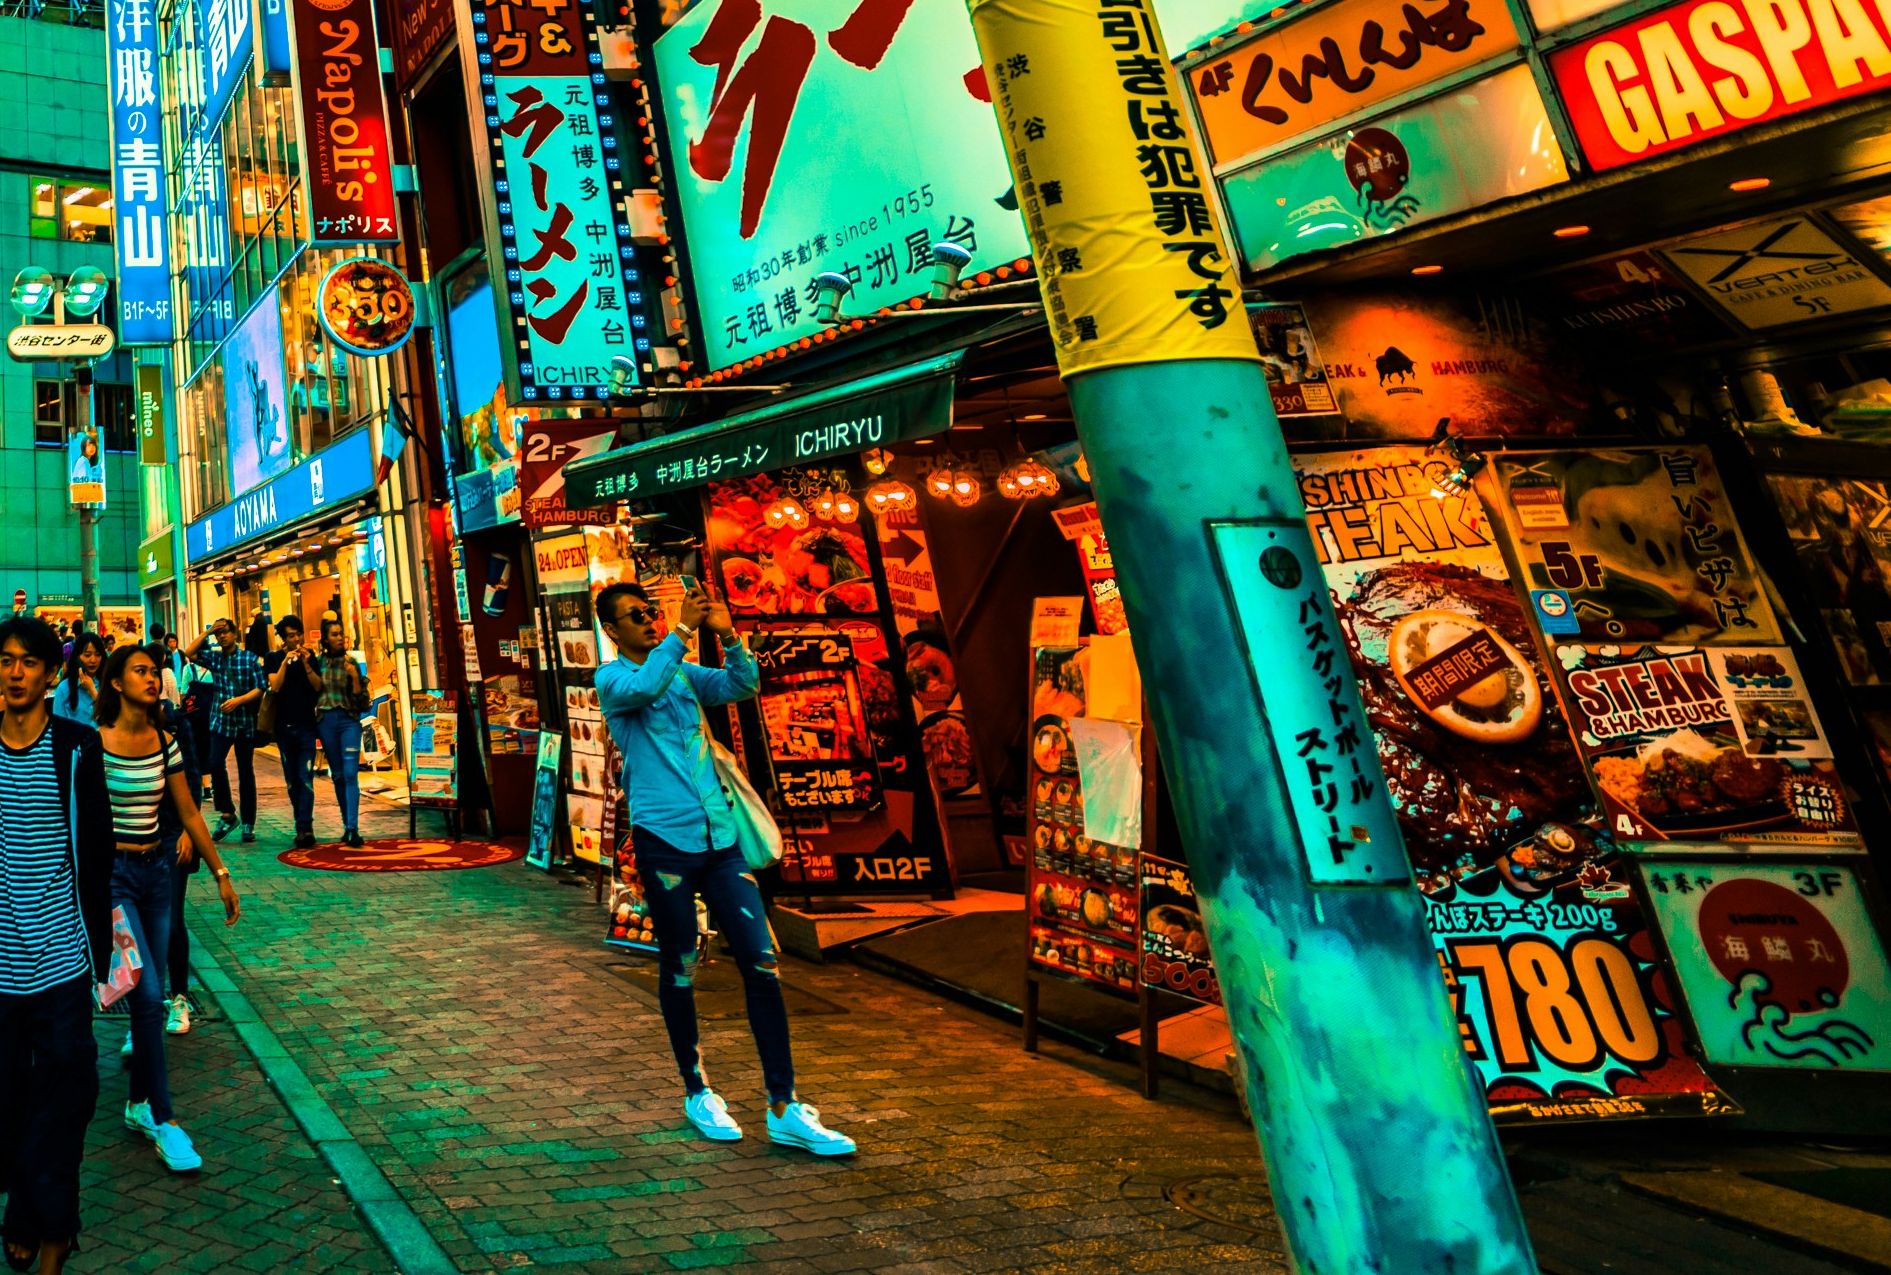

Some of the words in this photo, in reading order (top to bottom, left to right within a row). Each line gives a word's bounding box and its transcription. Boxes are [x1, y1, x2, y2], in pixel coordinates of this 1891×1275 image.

[1198, 63, 1234, 98] 4F
[320, 18, 377, 203] Napoli's
[1006, 53, 1099, 343] 渋谷警察署
[317, 215, 392, 235] ナポリス
[501, 84, 589, 345] ラーメン
[564, 84, 601, 202] 元祖博多
[585, 220, 627, 346] 中洲屋台
[732, 233, 829, 294] 昭和30年創業
[835, 214, 878, 248] since
[882, 183, 935, 226] 1955
[1614, 259, 1663, 285] 4F
[329, 289, 408, 322] 350
[1729, 291, 1765, 306] CAFE
[1778, 275, 1832, 296] DINING
[1562, 294, 1687, 330] KUISHINBO
[14, 333, 107, 348] 渋谷センター街
[1324, 363, 1356, 380] EAK
[1430, 358, 1508, 376] HAMBURG
[142, 391, 155, 438] mineo
[527, 432, 567, 463] 2F
[594, 472, 640, 499] 元祖博多
[656, 443, 770, 486] 中洲屋台ラーメン
[794, 415, 883, 459] ICHIRYU
[233, 485, 278, 539] AOYAMA
[1512, 491, 1548, 502] Welcome
[532, 510, 611, 524] HAMBURG
[1306, 495, 1492, 565] TEAK
[556, 545, 587, 570] OPEN
[1661, 452, 1758, 631] 旨いピザは
[1539, 541, 1606, 591] 5F
[819, 639, 850, 664] 2F
[1413, 638, 1501, 701] 期間限定
[1568, 652, 1725, 717] STEAK
[1298, 590, 1375, 806] バスケットボール
[778, 768, 854, 791] テーブル席
[1791, 781, 1830, 798] ライス
[784, 788, 855, 807] もございます
[1295, 727, 1355, 865] ストリート
[1615, 813, 1644, 837] 4F
[854, 856, 932, 883] 入口2F
[1795, 871, 1844, 897] 3F
[1550, 903, 1618, 933] 200g
